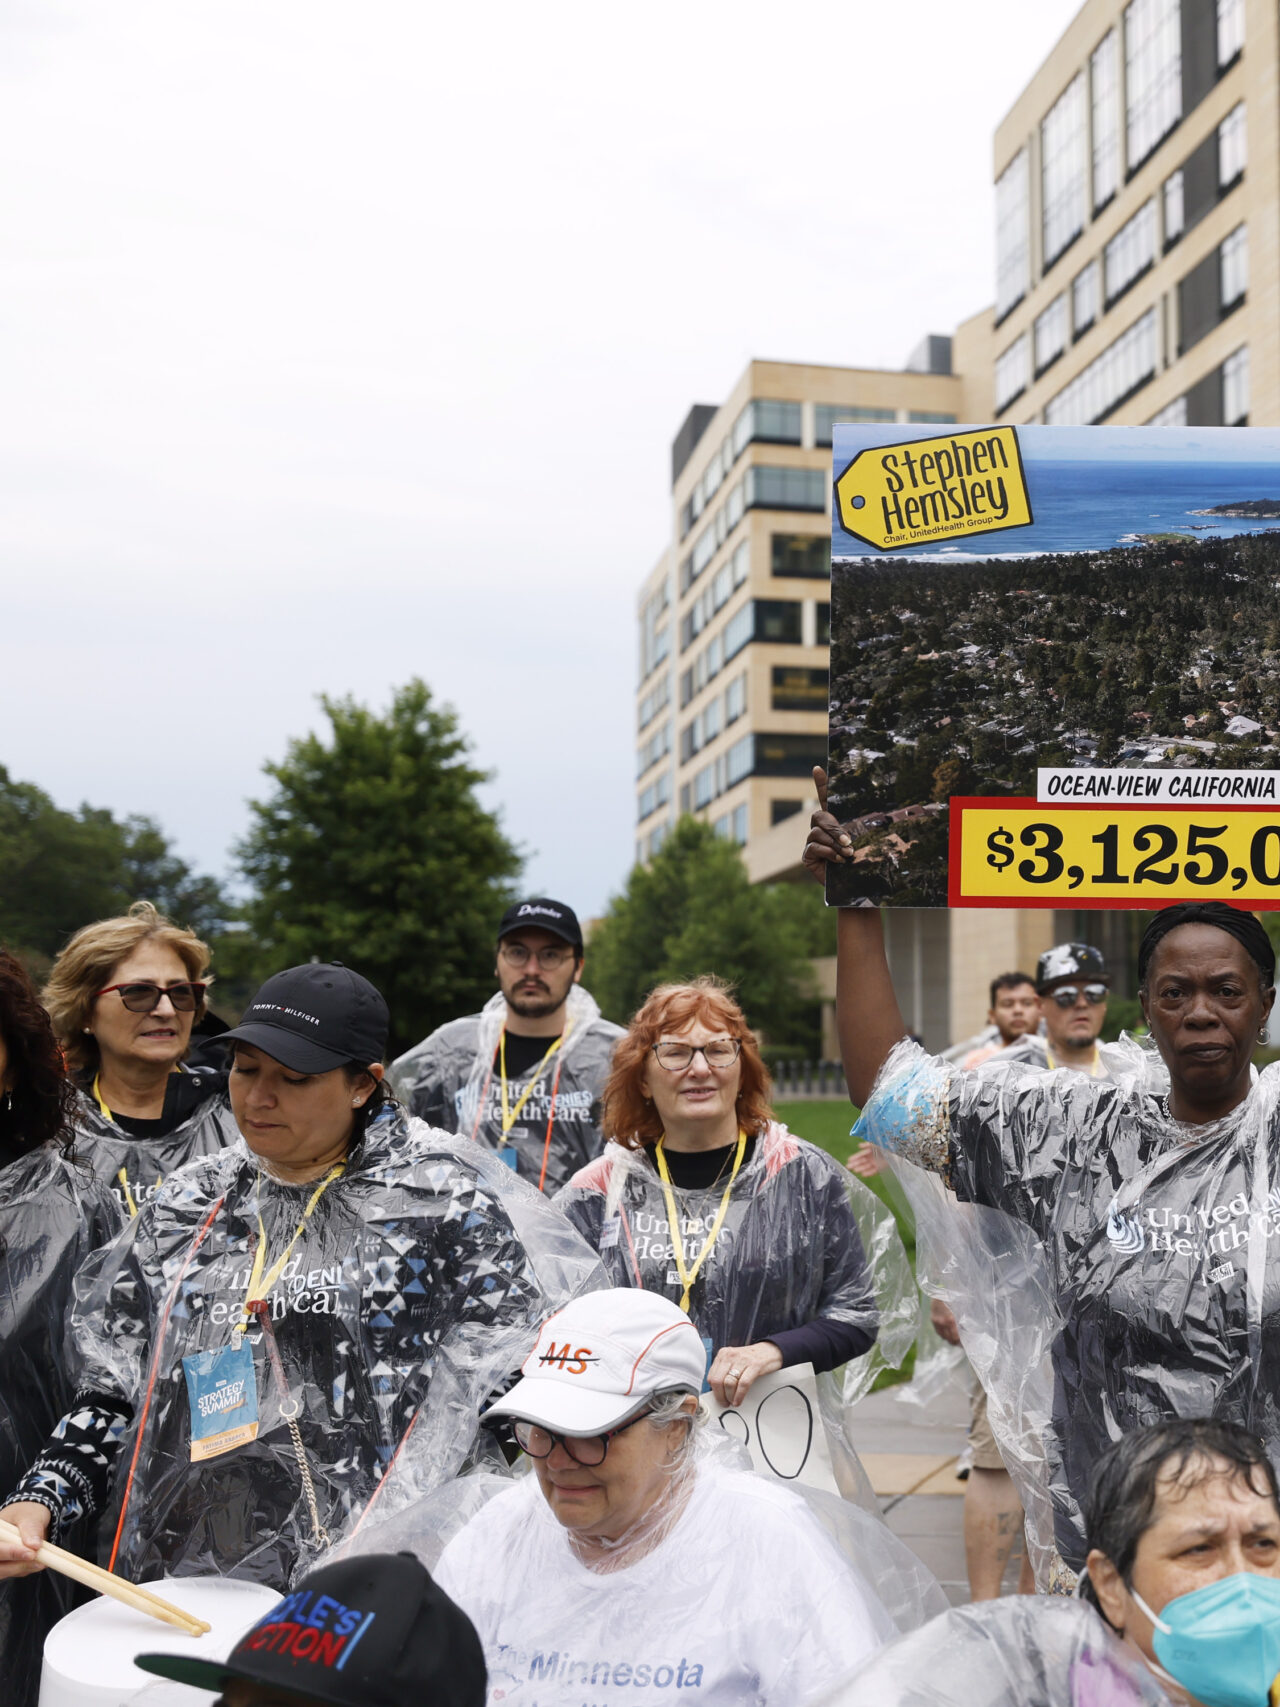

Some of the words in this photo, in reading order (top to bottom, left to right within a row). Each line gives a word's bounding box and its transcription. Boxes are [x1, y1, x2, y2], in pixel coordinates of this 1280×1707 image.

[881, 437, 1008, 492] Stephen
[881, 477, 1009, 534] Hemsley
[883, 533, 909, 544] Chair,
[909, 521, 965, 539] UnitedHealth
[967, 516, 994, 528] Group
[1047, 775, 1162, 797] OCEAN-VIEW
[1168, 776, 1276, 798] CALIFORNIA
[284, 1007, 321, 1026] HILFIGER
[198, 1379, 245, 1409] STRATEGY
[201, 1391, 242, 1417] SUMMIT
[528, 1651, 704, 1689] Minnesota
